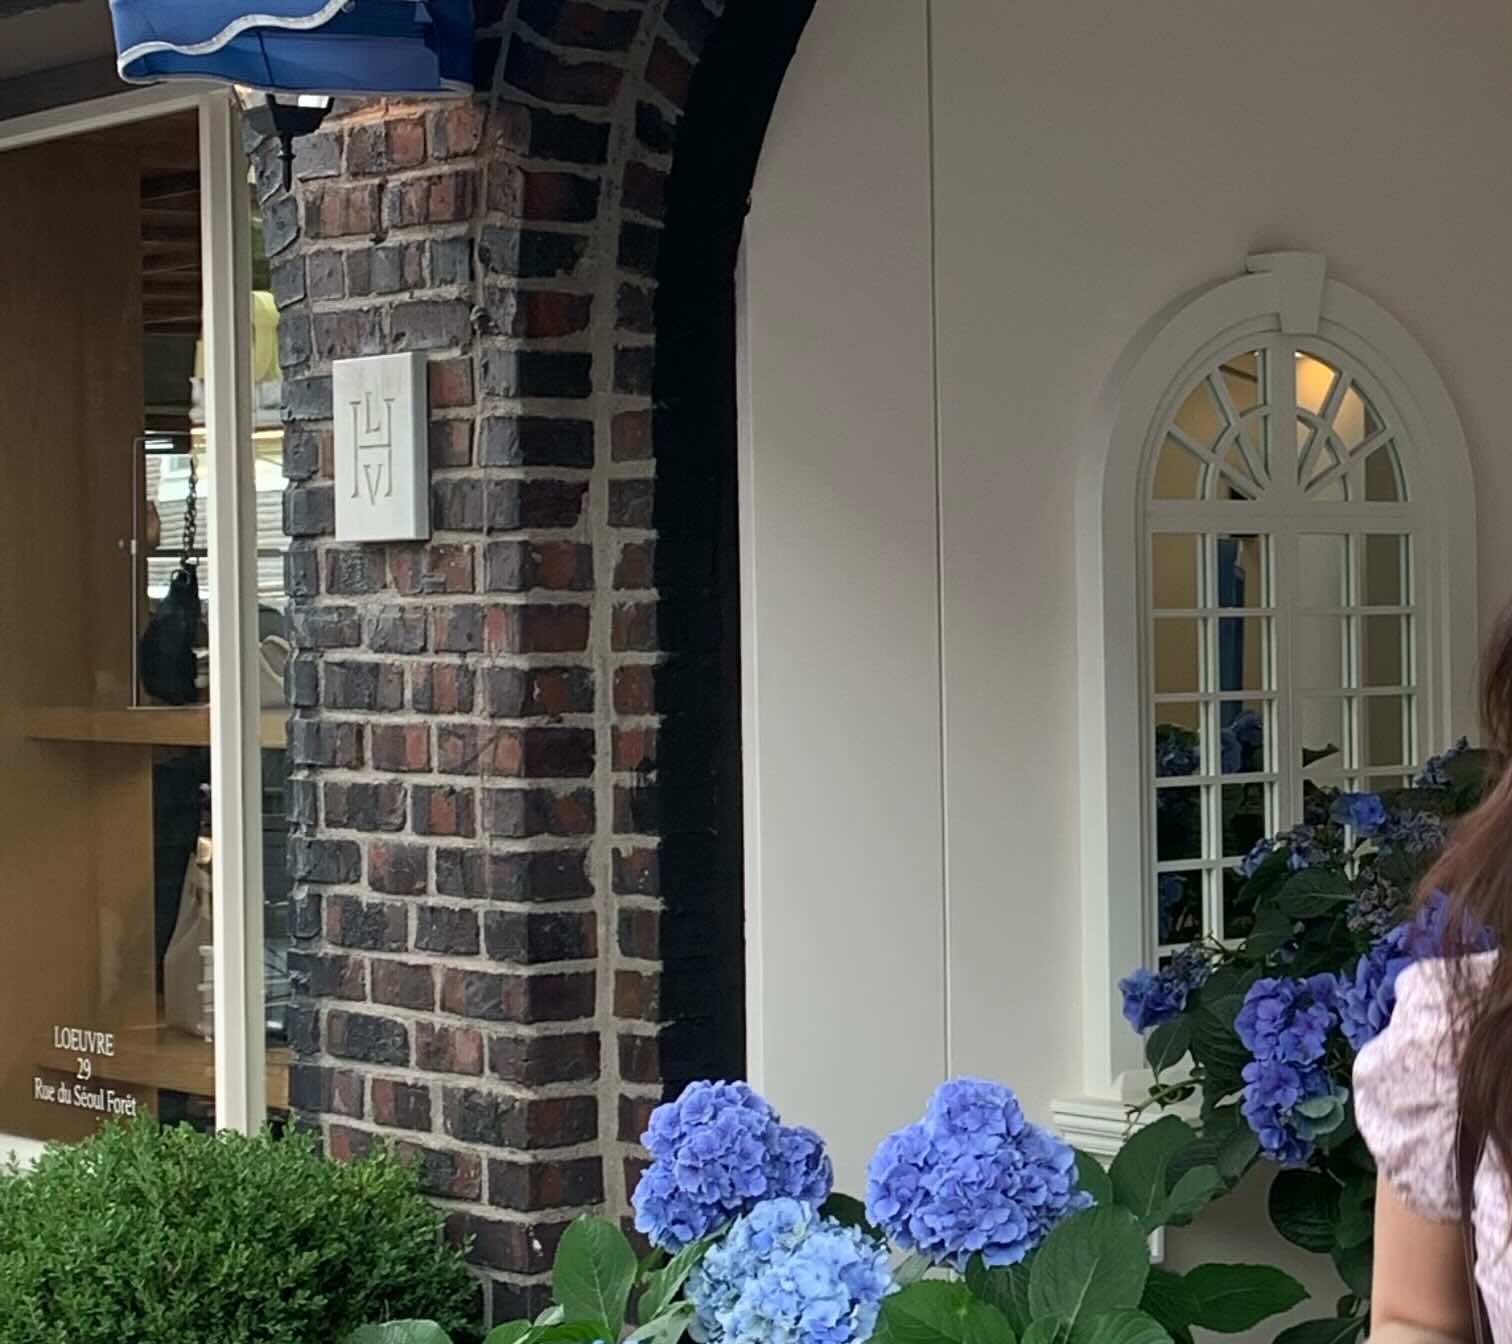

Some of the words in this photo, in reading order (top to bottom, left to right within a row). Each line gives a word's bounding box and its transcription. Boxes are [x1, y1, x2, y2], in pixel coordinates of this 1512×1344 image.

[53, 1025, 115, 1056] LOEUVRE
[76, 1057, 91, 1080] 29
[33, 1077, 55, 1102] Rue
[57, 1081, 72, 1105] du
